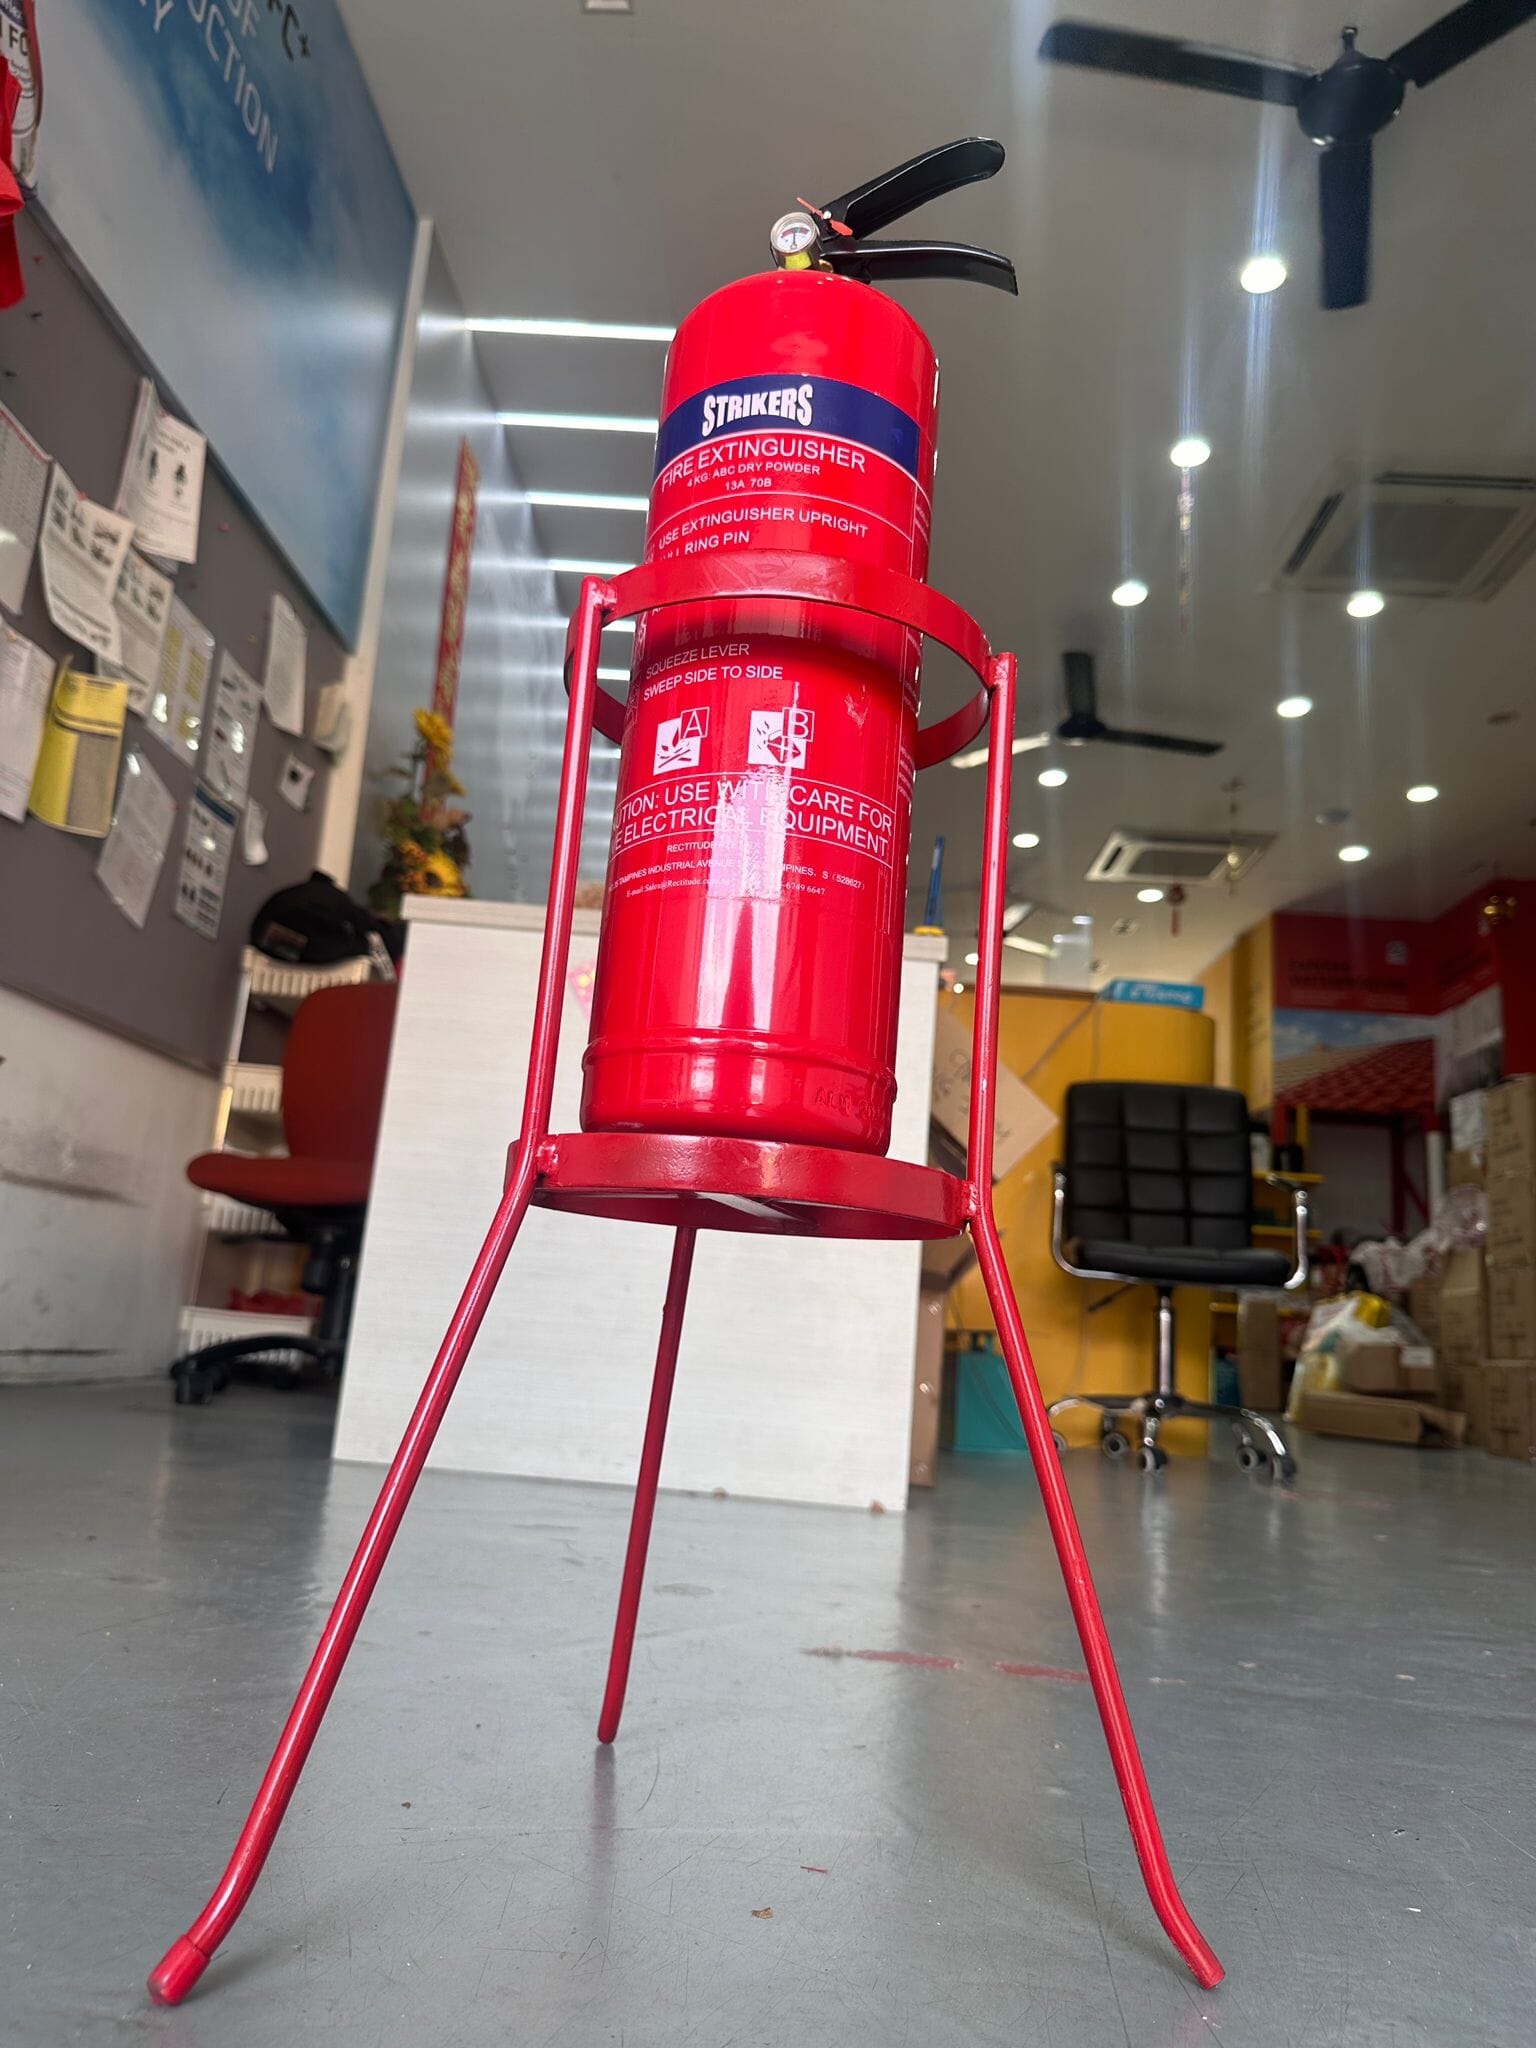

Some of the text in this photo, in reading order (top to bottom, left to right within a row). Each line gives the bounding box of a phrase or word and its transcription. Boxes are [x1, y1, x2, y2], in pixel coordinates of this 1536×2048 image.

[701, 383, 813, 437] STRIKERS
[661, 438, 866, 493] FIRE EXTINGUISHER
[712, 465, 736, 479] ABC
[738, 462, 763, 474] DRY
[765, 461, 820, 475] POWDER
[725, 477, 772, 491] 13A 70B
[659, 507, 868, 550] USE EXTINGUISHER UPRIGHT
[684, 535, 719, 556] RING
[723, 530, 750, 546] PIN
[646, 643, 750, 679] SQUEEZE LEVER
[643, 665, 783, 701] SWEEP SIDE TO SIDE
[683, 710, 703, 737] A
[791, 711, 810, 738] B
[665, 781, 711, 806] USE
[789, 785, 854, 818] CARE
[858, 802, 893, 837] FOR
[623, 805, 753, 845] ELECTRICAL
[760, 806, 889, 858] EQUIPMENT
[666, 841, 714, 854] RECTITUDE
[648, 860, 695, 876] INDUSTRIAL
